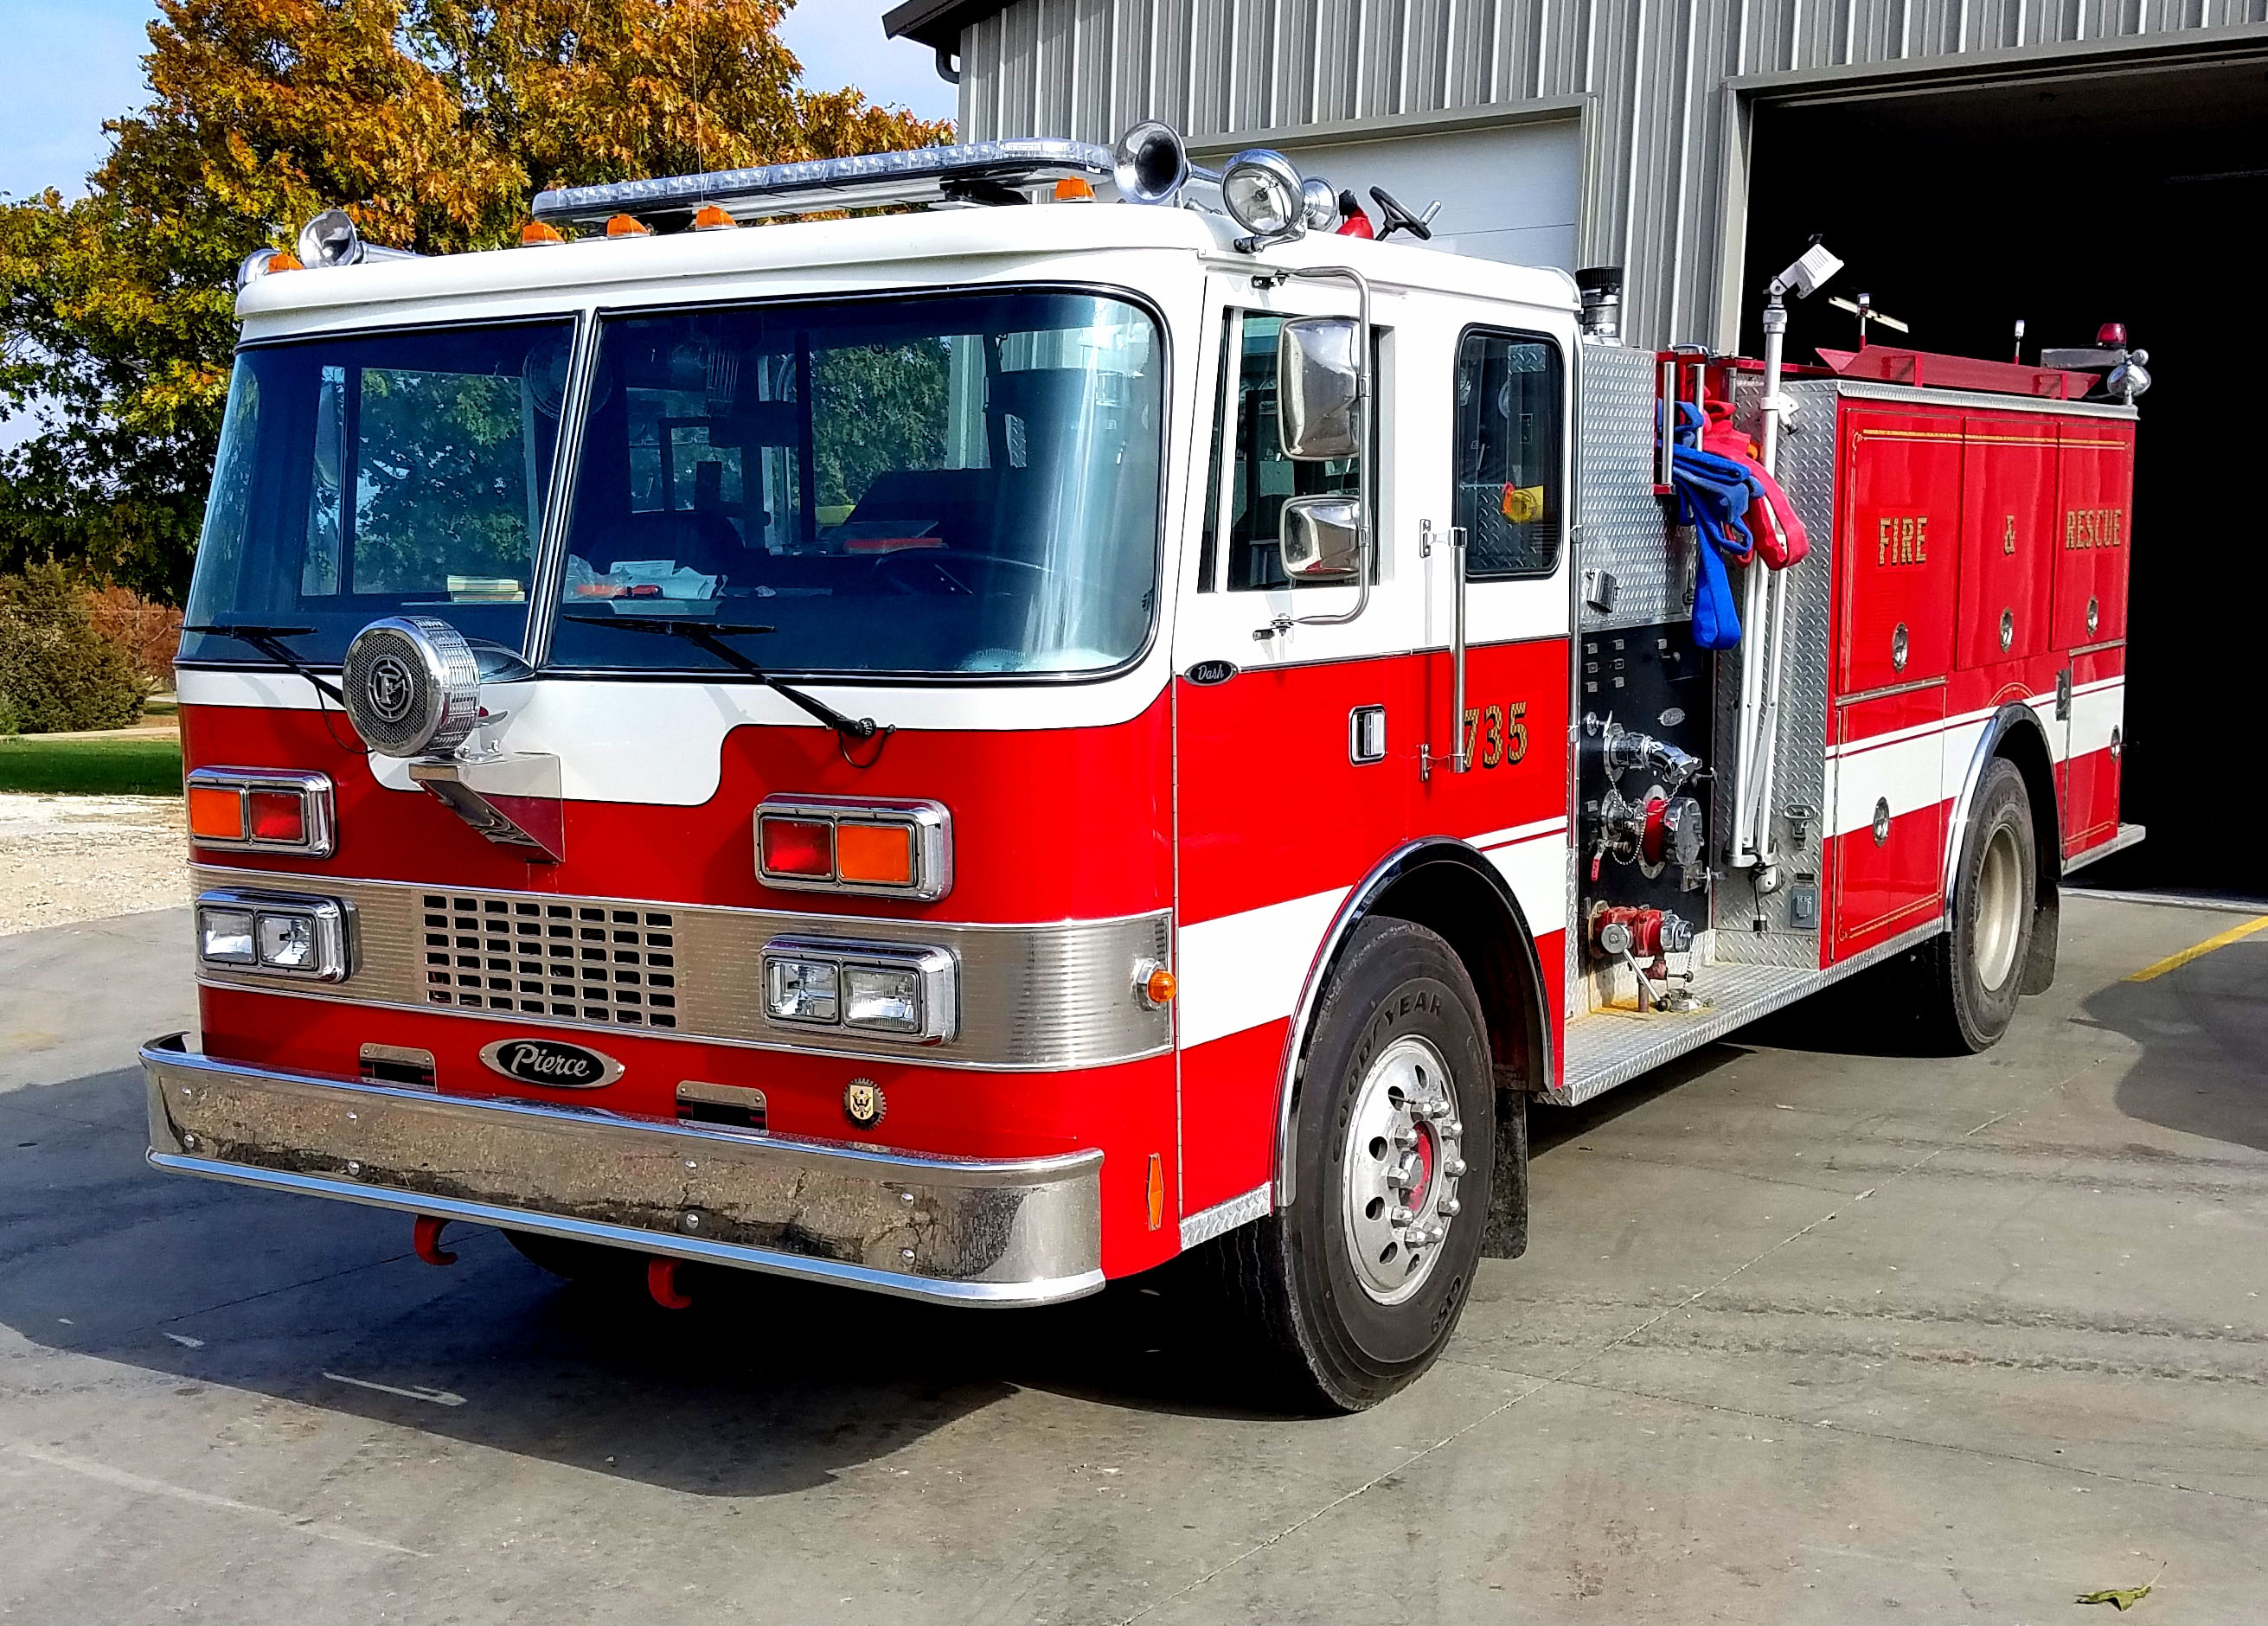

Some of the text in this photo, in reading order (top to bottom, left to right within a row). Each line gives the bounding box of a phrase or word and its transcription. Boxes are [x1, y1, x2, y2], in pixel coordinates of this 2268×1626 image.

[1878, 508, 2122, 566] FIRE & RESCUE
[1197, 663, 1225, 681] Dash
[1464, 701, 1528, 771] 735
[510, 1043, 591, 1078] Pierce
